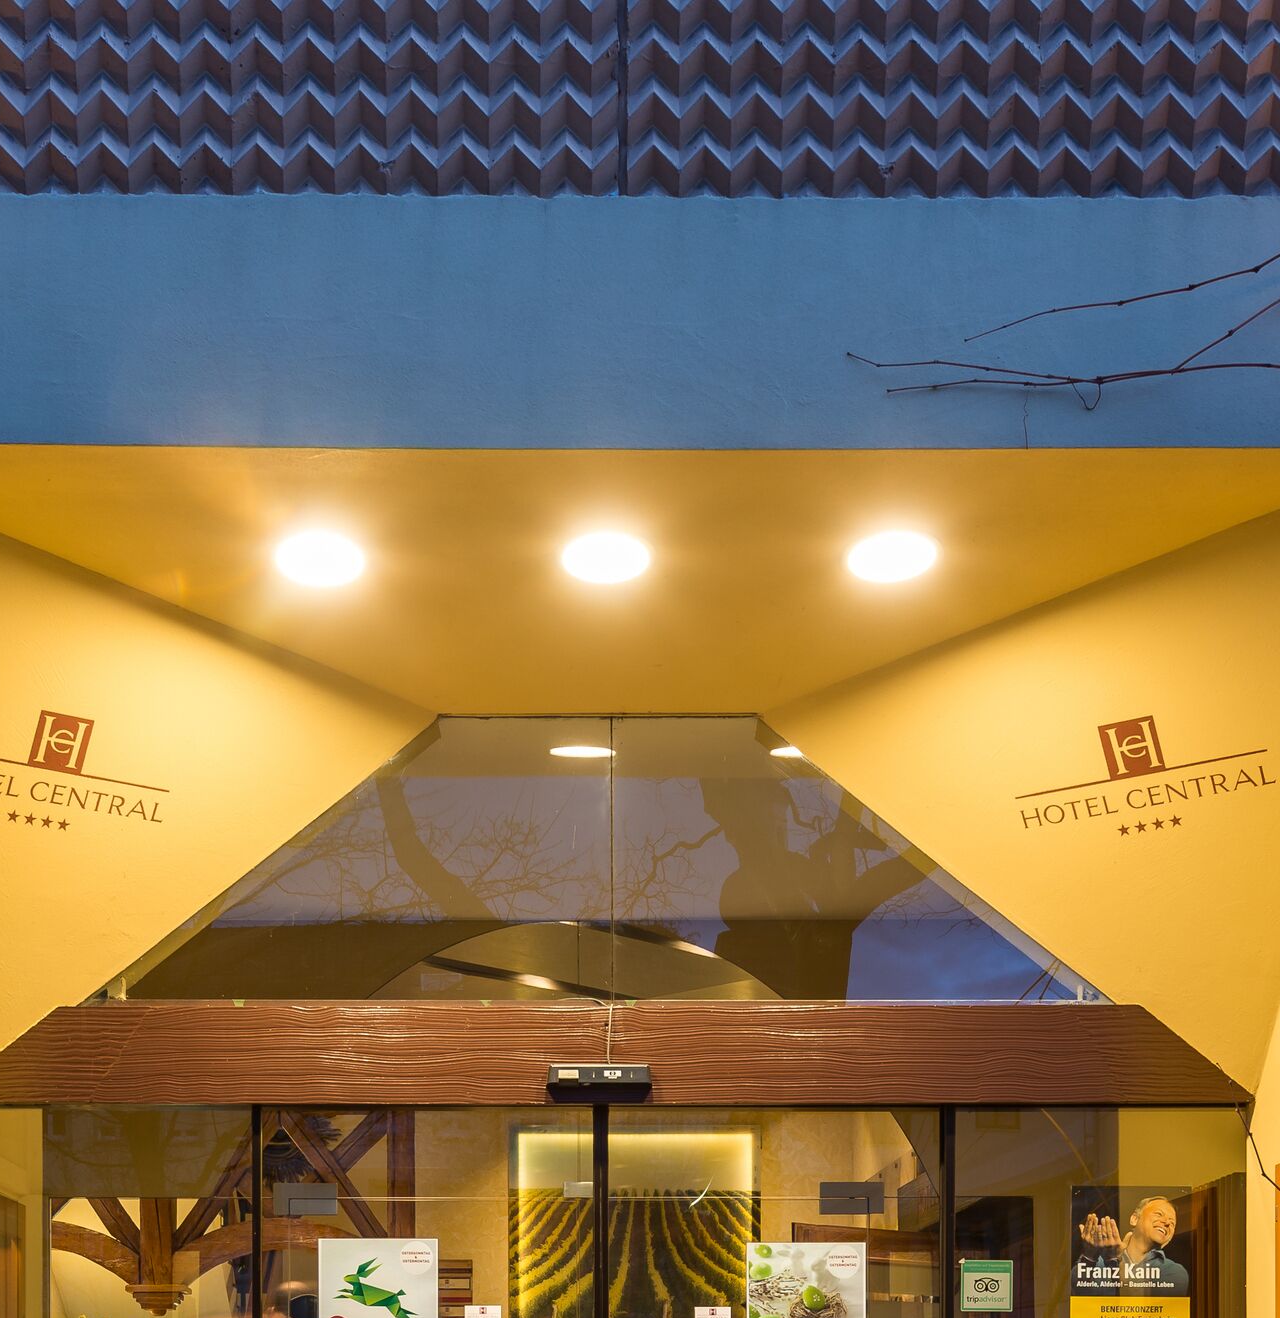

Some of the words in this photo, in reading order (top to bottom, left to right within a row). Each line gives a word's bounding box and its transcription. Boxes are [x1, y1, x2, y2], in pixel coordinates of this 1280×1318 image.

[30, 781, 163, 823] CENTRAL
[1020, 796, 1119, 829] HOTEL
[1126, 765, 1277, 810] CENTRAL
[1077, 1263, 1120, 1279] Franz
[1124, 1263, 1160, 1279] Kain
[966, 1296, 1006, 1304] tripadvisor
